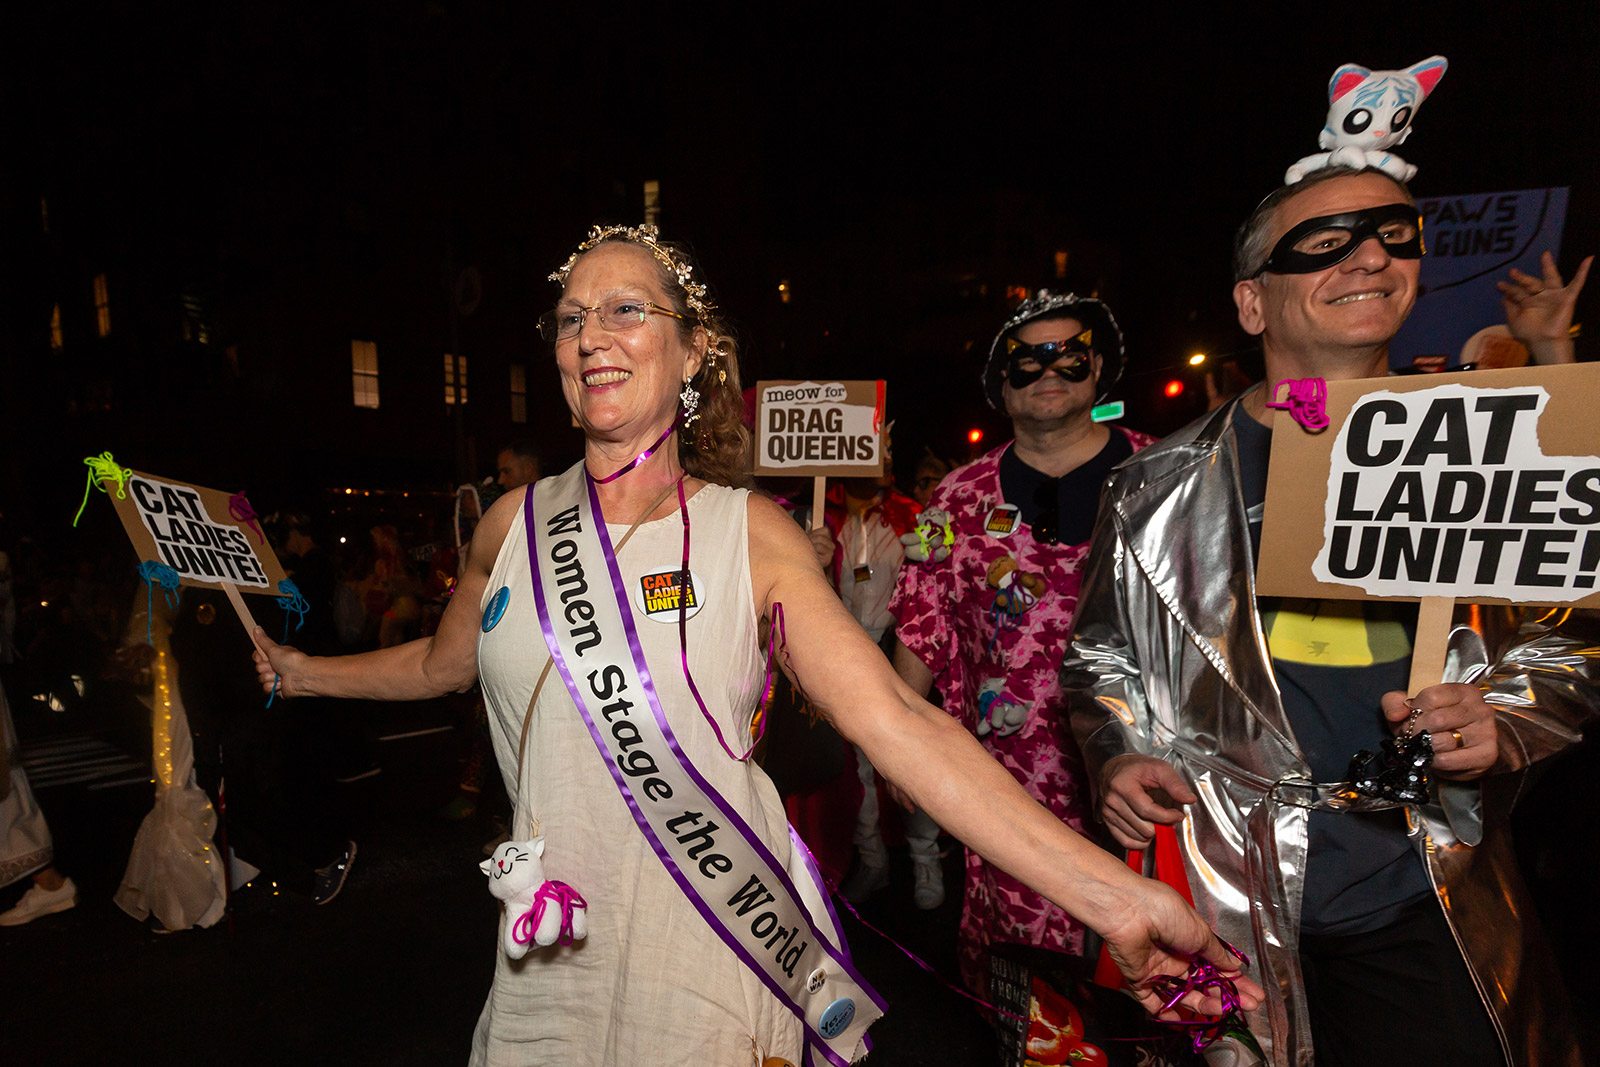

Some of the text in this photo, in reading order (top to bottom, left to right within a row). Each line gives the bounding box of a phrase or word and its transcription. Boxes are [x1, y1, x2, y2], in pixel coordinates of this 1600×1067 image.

[1422, 196, 1518, 225] PAWS
[1434, 227, 1517, 257] GUNS
[767, 386, 845, 402] meow for
[769, 408, 843, 433] DRAG
[1346, 394, 1539, 467] CAT
[767, 435, 874, 463] QUEENS
[132, 480, 204, 522] CAT
[1335, 468, 1600, 525] LADIES
[145, 513, 252, 555] LADIES
[159, 542, 268, 584] UNITE!
[1328, 526, 1600, 589] UNITE!
[643, 573, 673, 590] CAT
[547, 504, 808, 979] Women Stage the World
